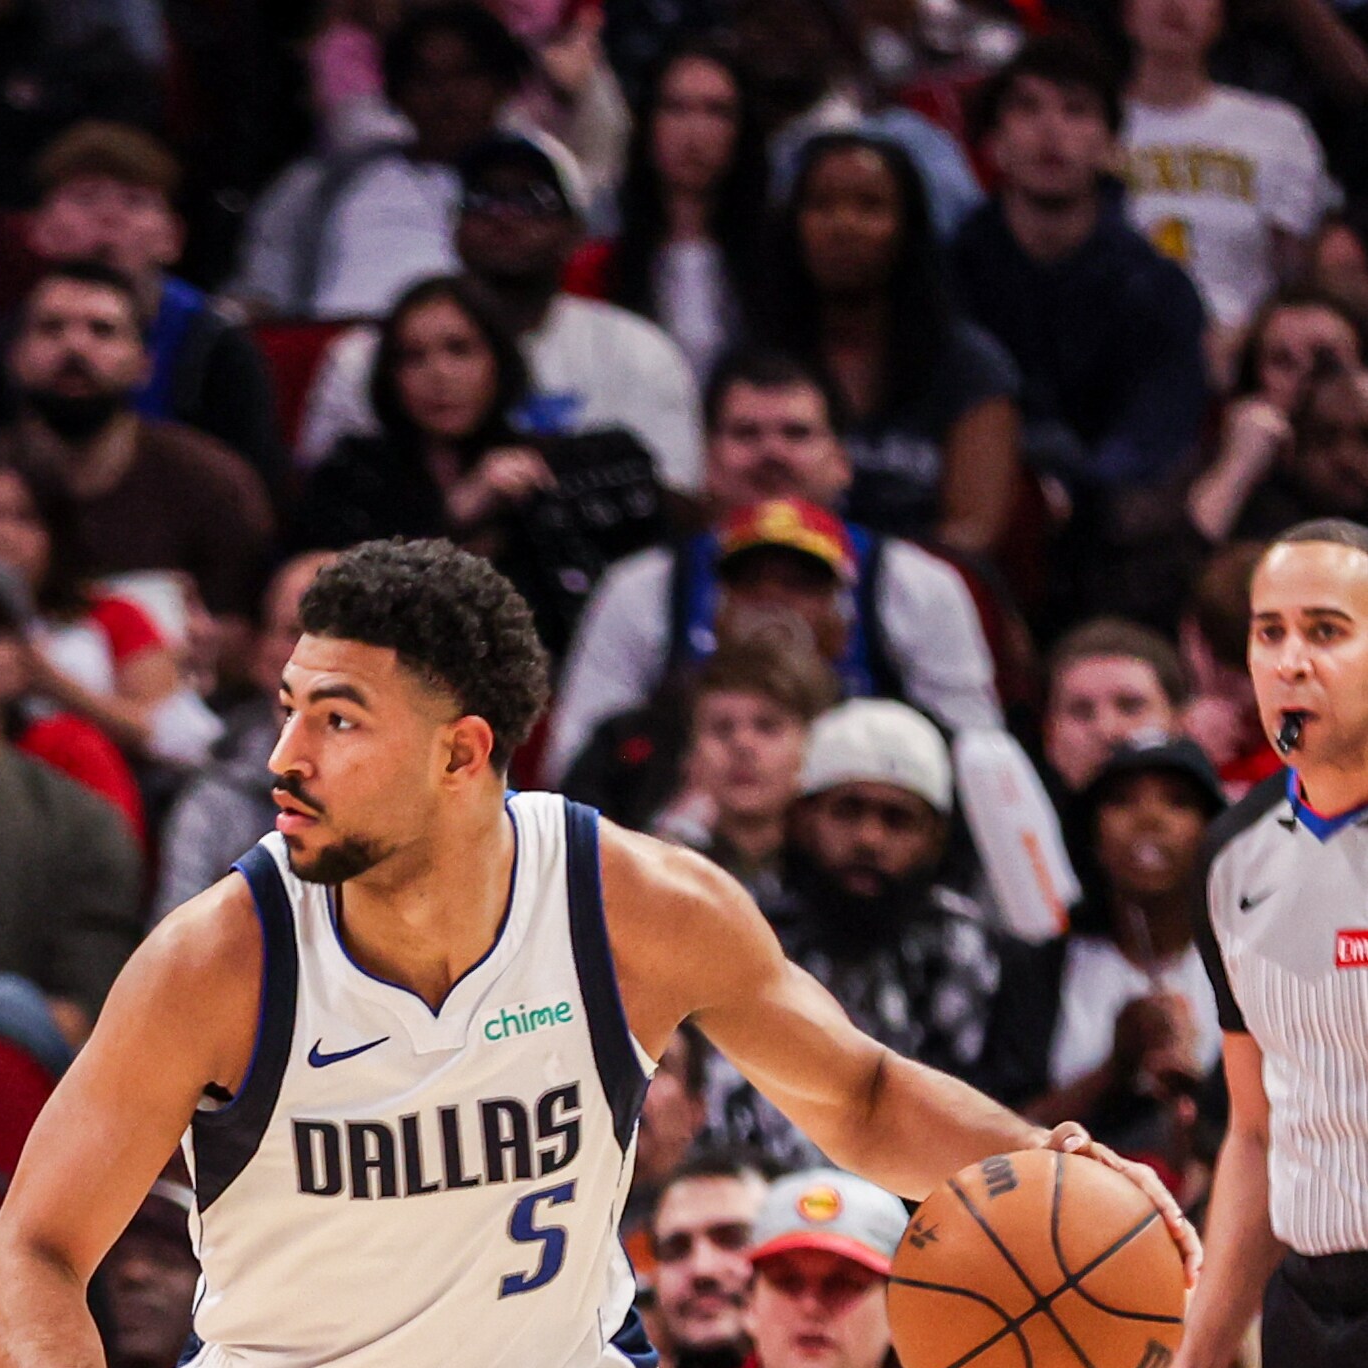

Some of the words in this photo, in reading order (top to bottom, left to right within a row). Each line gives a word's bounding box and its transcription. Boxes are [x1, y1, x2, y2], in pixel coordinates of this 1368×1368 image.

[483, 1000, 574, 1041] chime
[291, 1080, 583, 1200] DALLAS
[497, 1177, 579, 1301] 5
